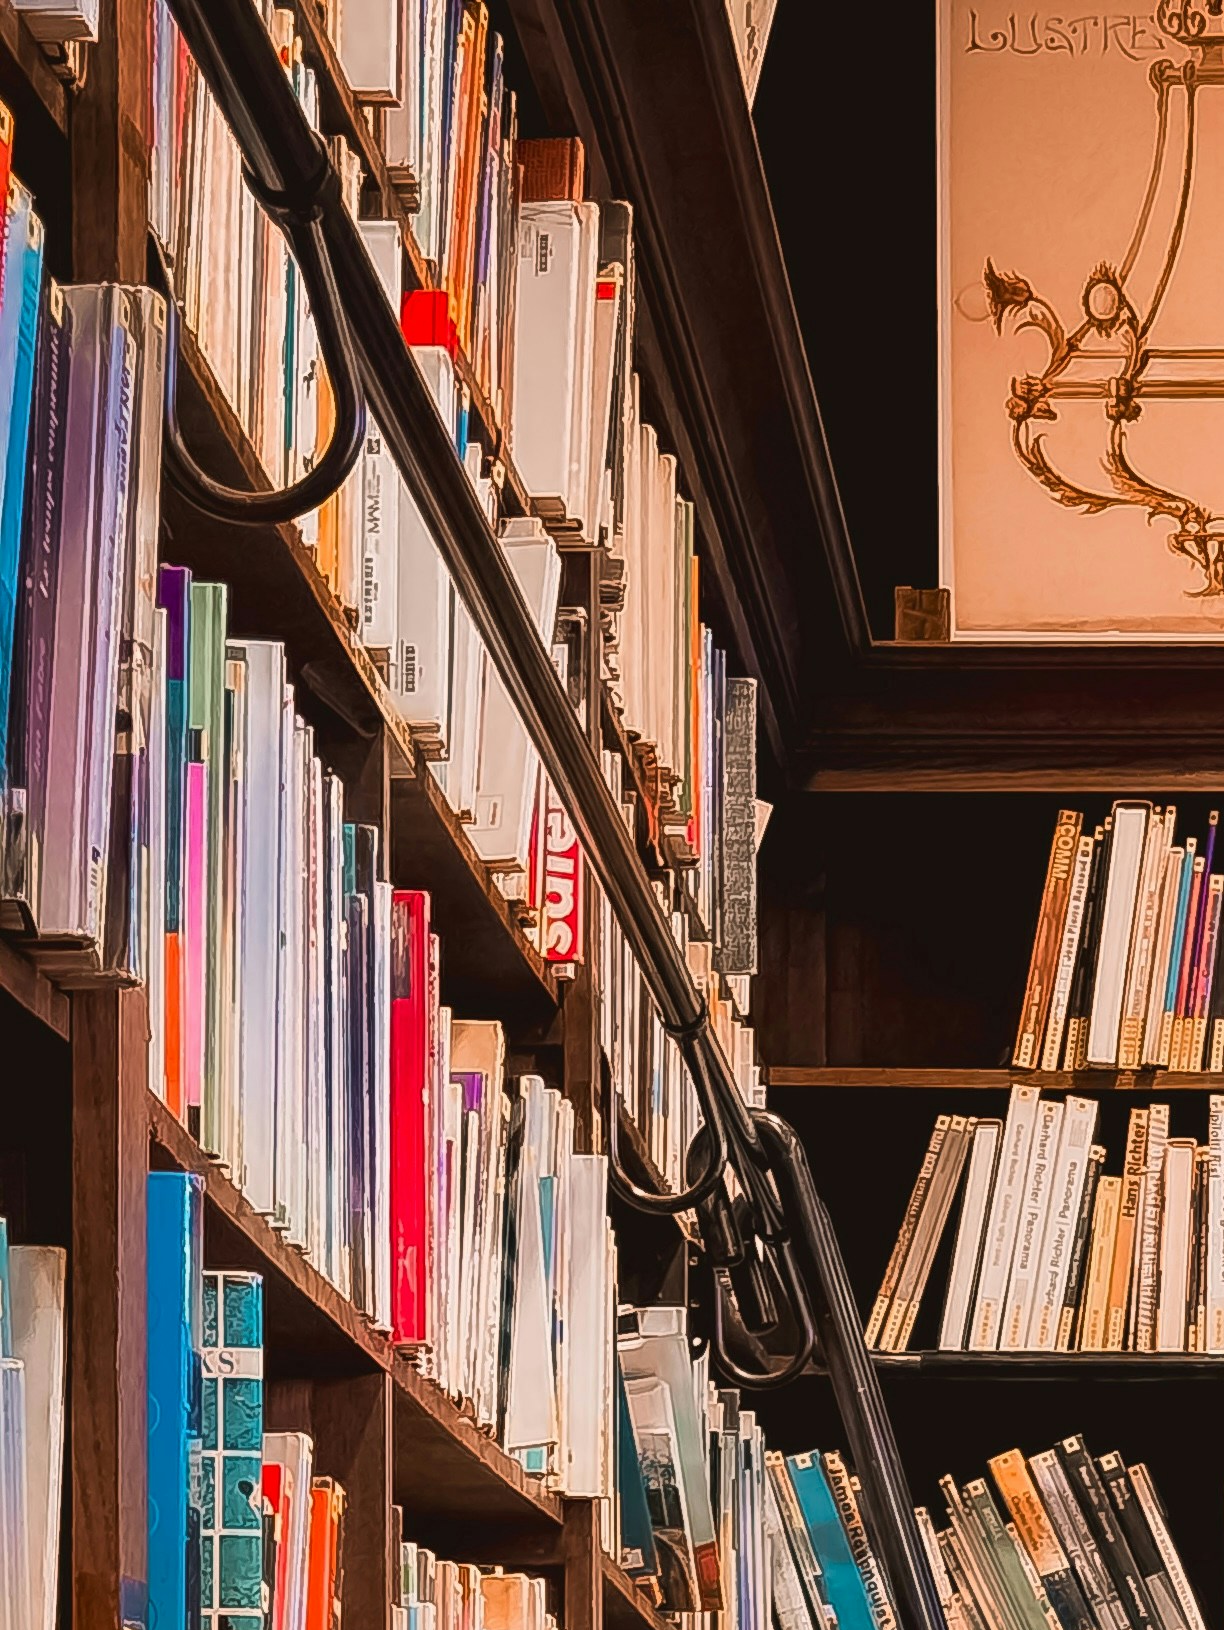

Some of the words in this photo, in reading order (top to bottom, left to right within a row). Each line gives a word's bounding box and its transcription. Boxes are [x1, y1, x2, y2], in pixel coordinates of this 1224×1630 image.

[966, 10, 1166, 61] LUSTRE
[1127, 1122, 1147, 1177] Richter
[1029, 1163, 1047, 1204] Richter
[1057, 1161, 1078, 1219] Panorama
[1122, 1180, 1141, 1217] Hans
[1019, 1212, 1039, 1270] Panorama
[1049, 1227, 1067, 1268] Richter
